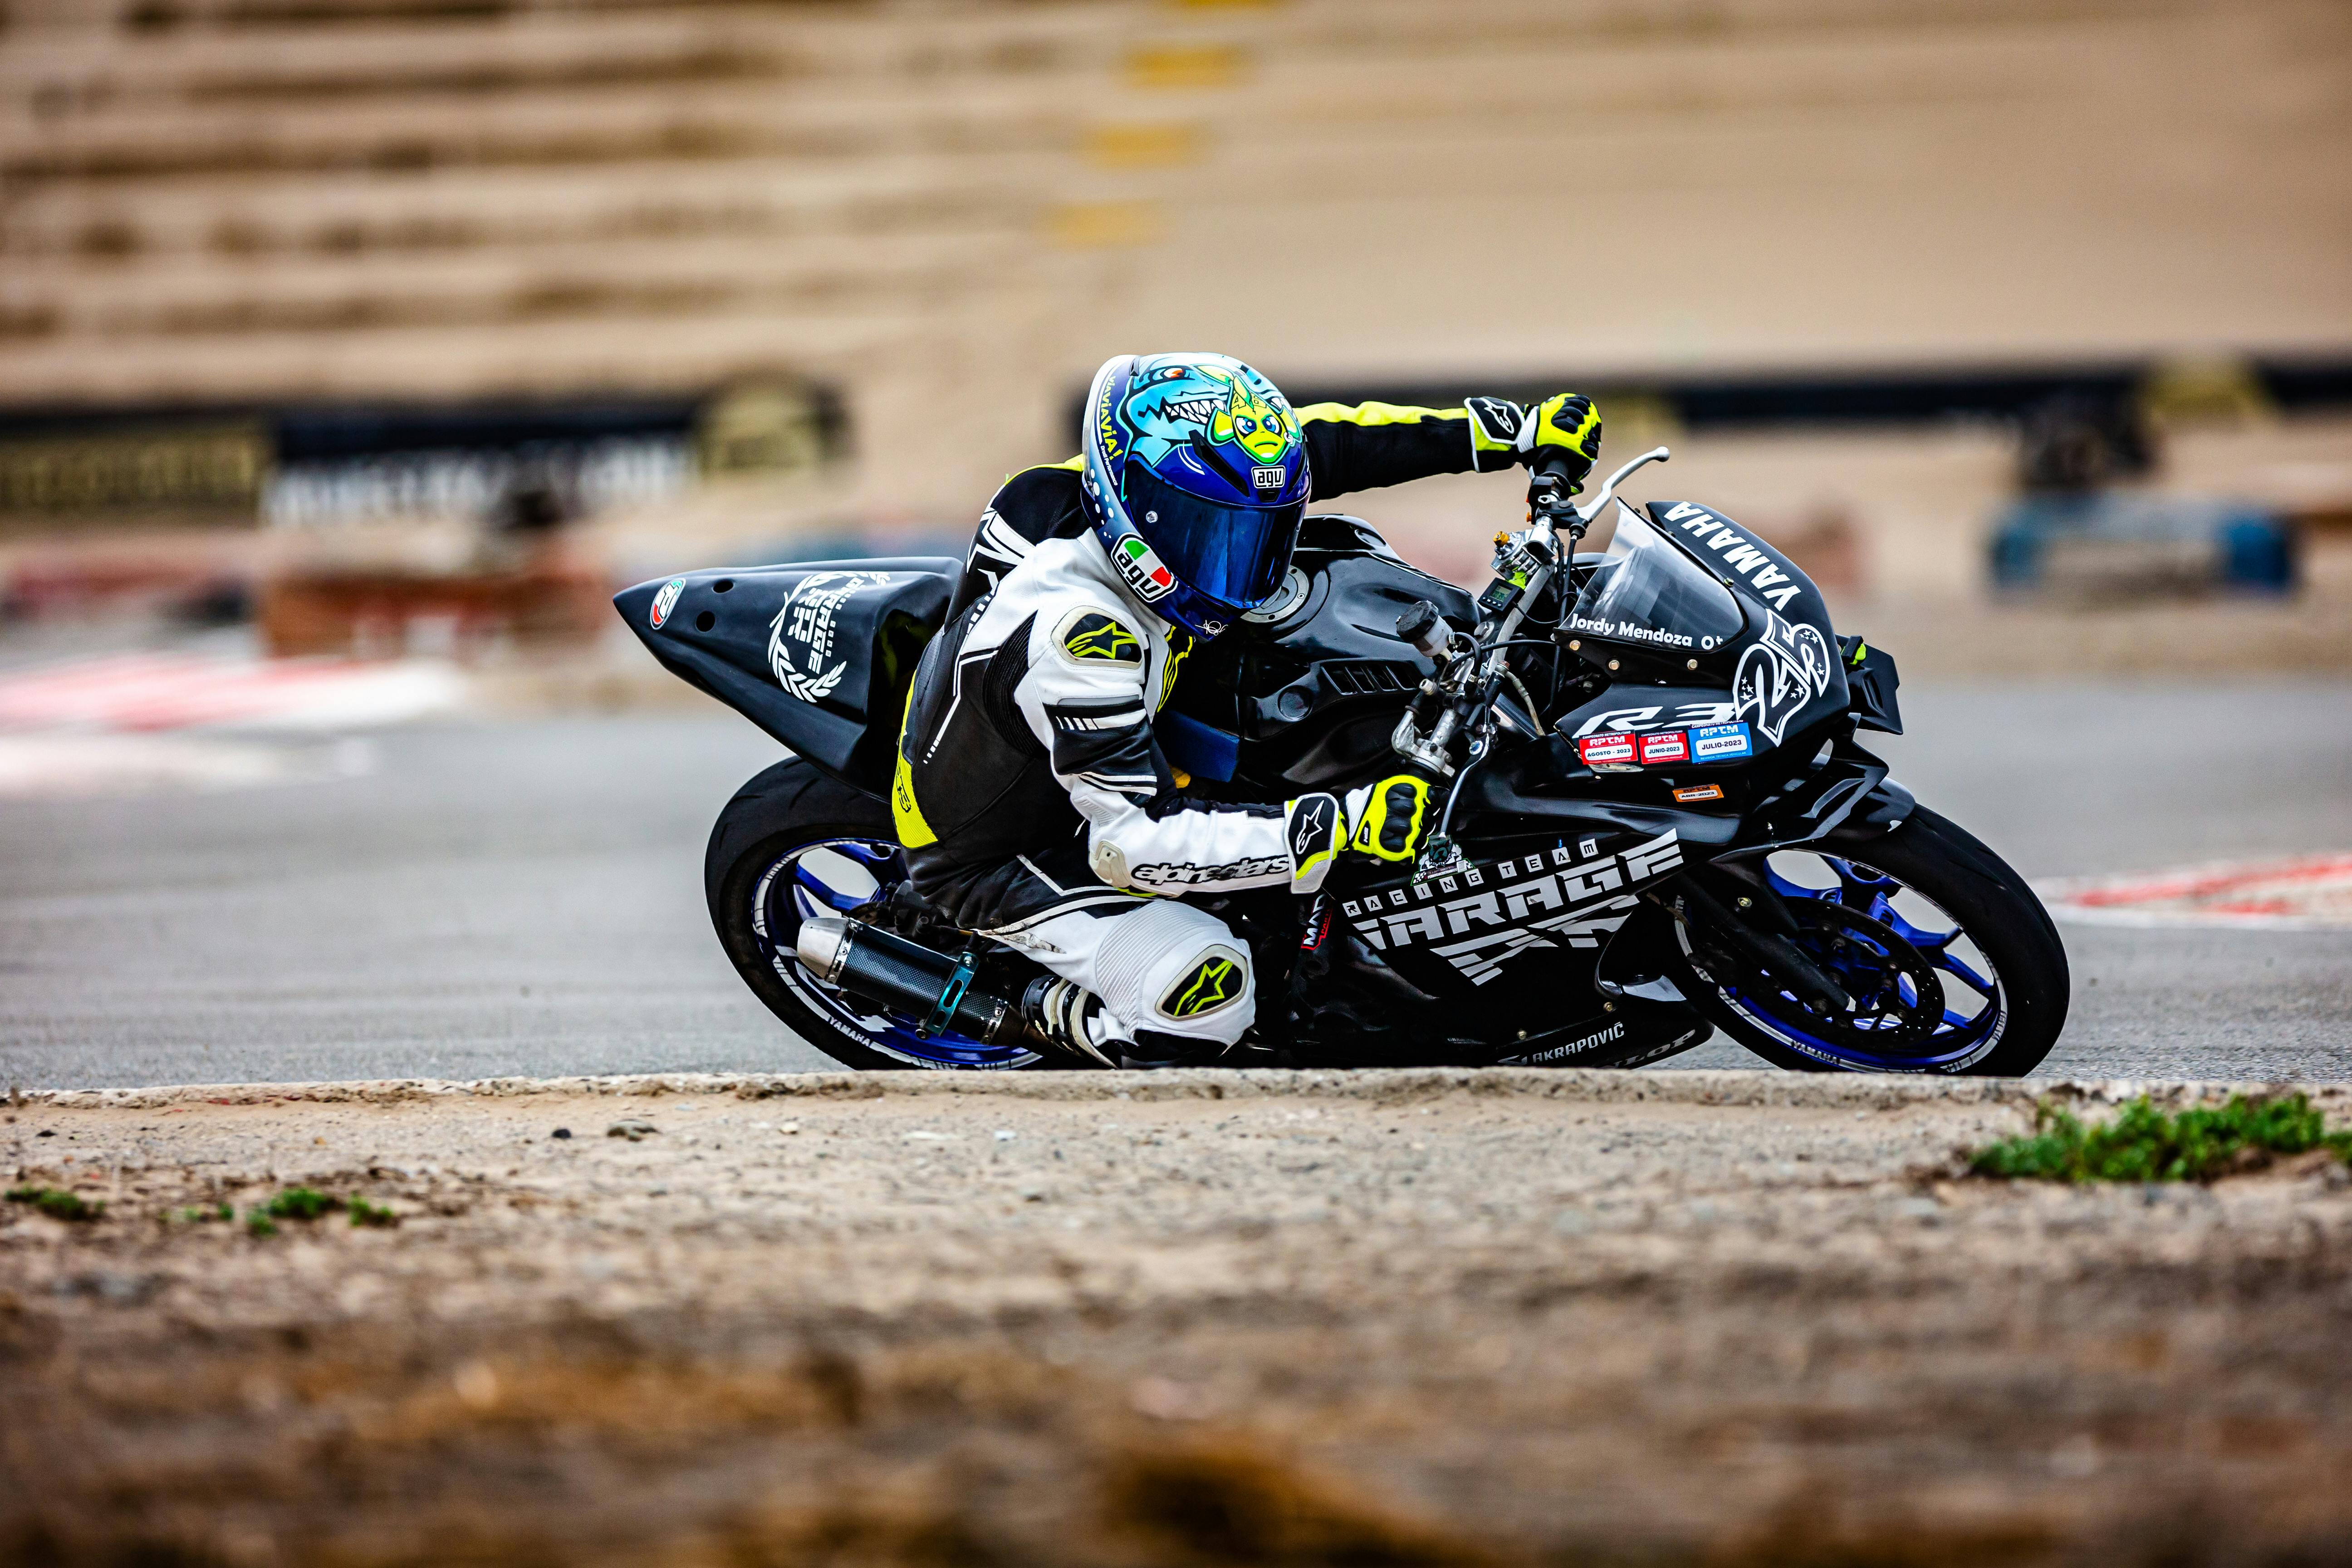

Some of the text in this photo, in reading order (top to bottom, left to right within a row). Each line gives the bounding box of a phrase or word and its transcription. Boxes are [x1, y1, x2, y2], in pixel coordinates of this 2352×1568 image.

[1104, 456, 1118, 486] Performance
[1258, 470, 1282, 487] agv
[1664, 501, 1802, 611] YAMAHA
[1117, 552, 1161, 594] agv
[1570, 613, 1615, 635] Jordy
[1618, 621, 1693, 647] Mendoza
[1702, 740, 1742, 750] JULIO-2023
[1344, 839, 1597, 916] RACING TEAM
[829, 1016, 871, 1047] YAMAHA
[1791, 1039, 1841, 1064] YAMAHA
